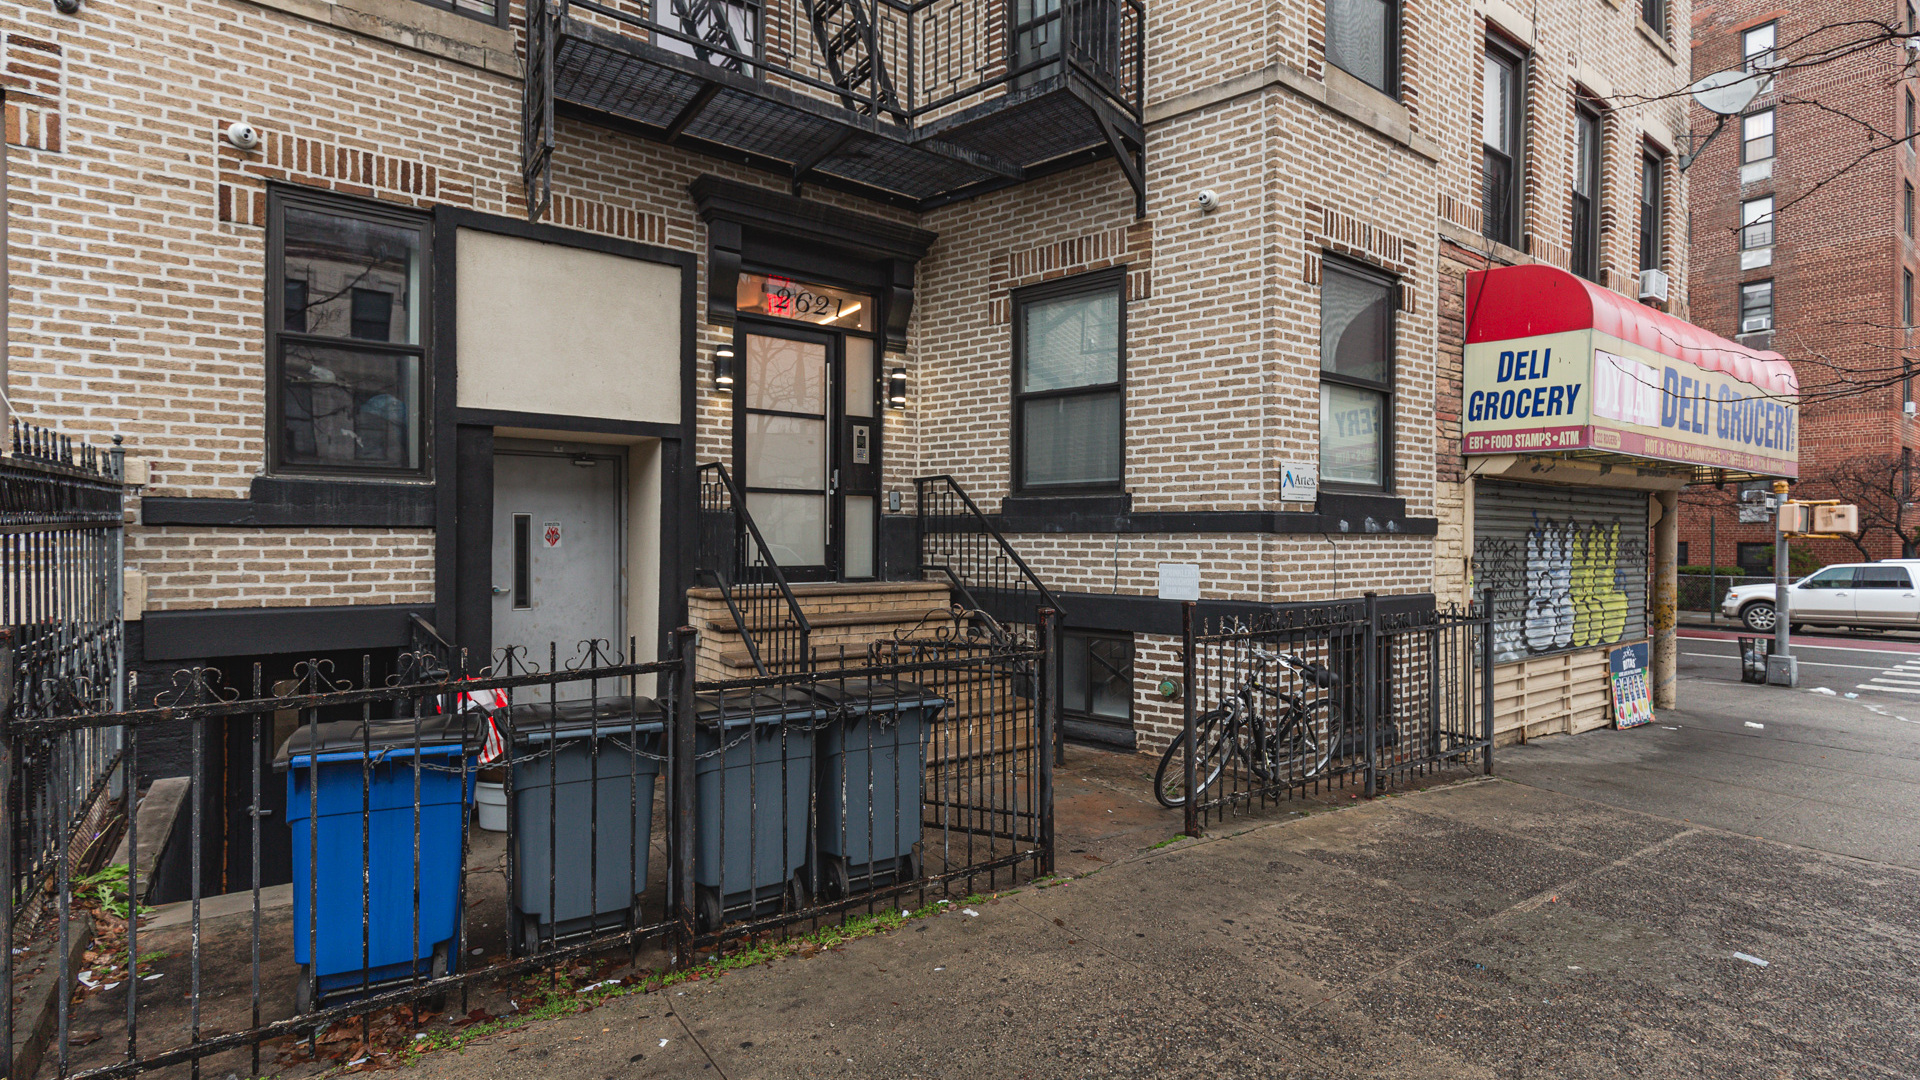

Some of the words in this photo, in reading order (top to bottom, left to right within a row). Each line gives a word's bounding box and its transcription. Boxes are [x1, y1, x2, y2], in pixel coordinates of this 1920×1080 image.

[774, 288, 843, 317] 2621
[1496, 348, 1551, 383] DELI
[1468, 383, 1581, 422] GROCERY
[1661, 366, 1711, 435] DELI
[1717, 383, 1794, 452] GROCERY
[1469, 436, 1484, 449] EBT
[1491, 434, 1513, 448] FOOD
[1515, 432, 1551, 447] STAMPS
[1559, 430, 1580, 446] ATM
[1645, 438, 1658, 454] HOT
[1666, 442, 1683, 458] COLD
[1684, 445, 1721, 464] SANDWICHES
